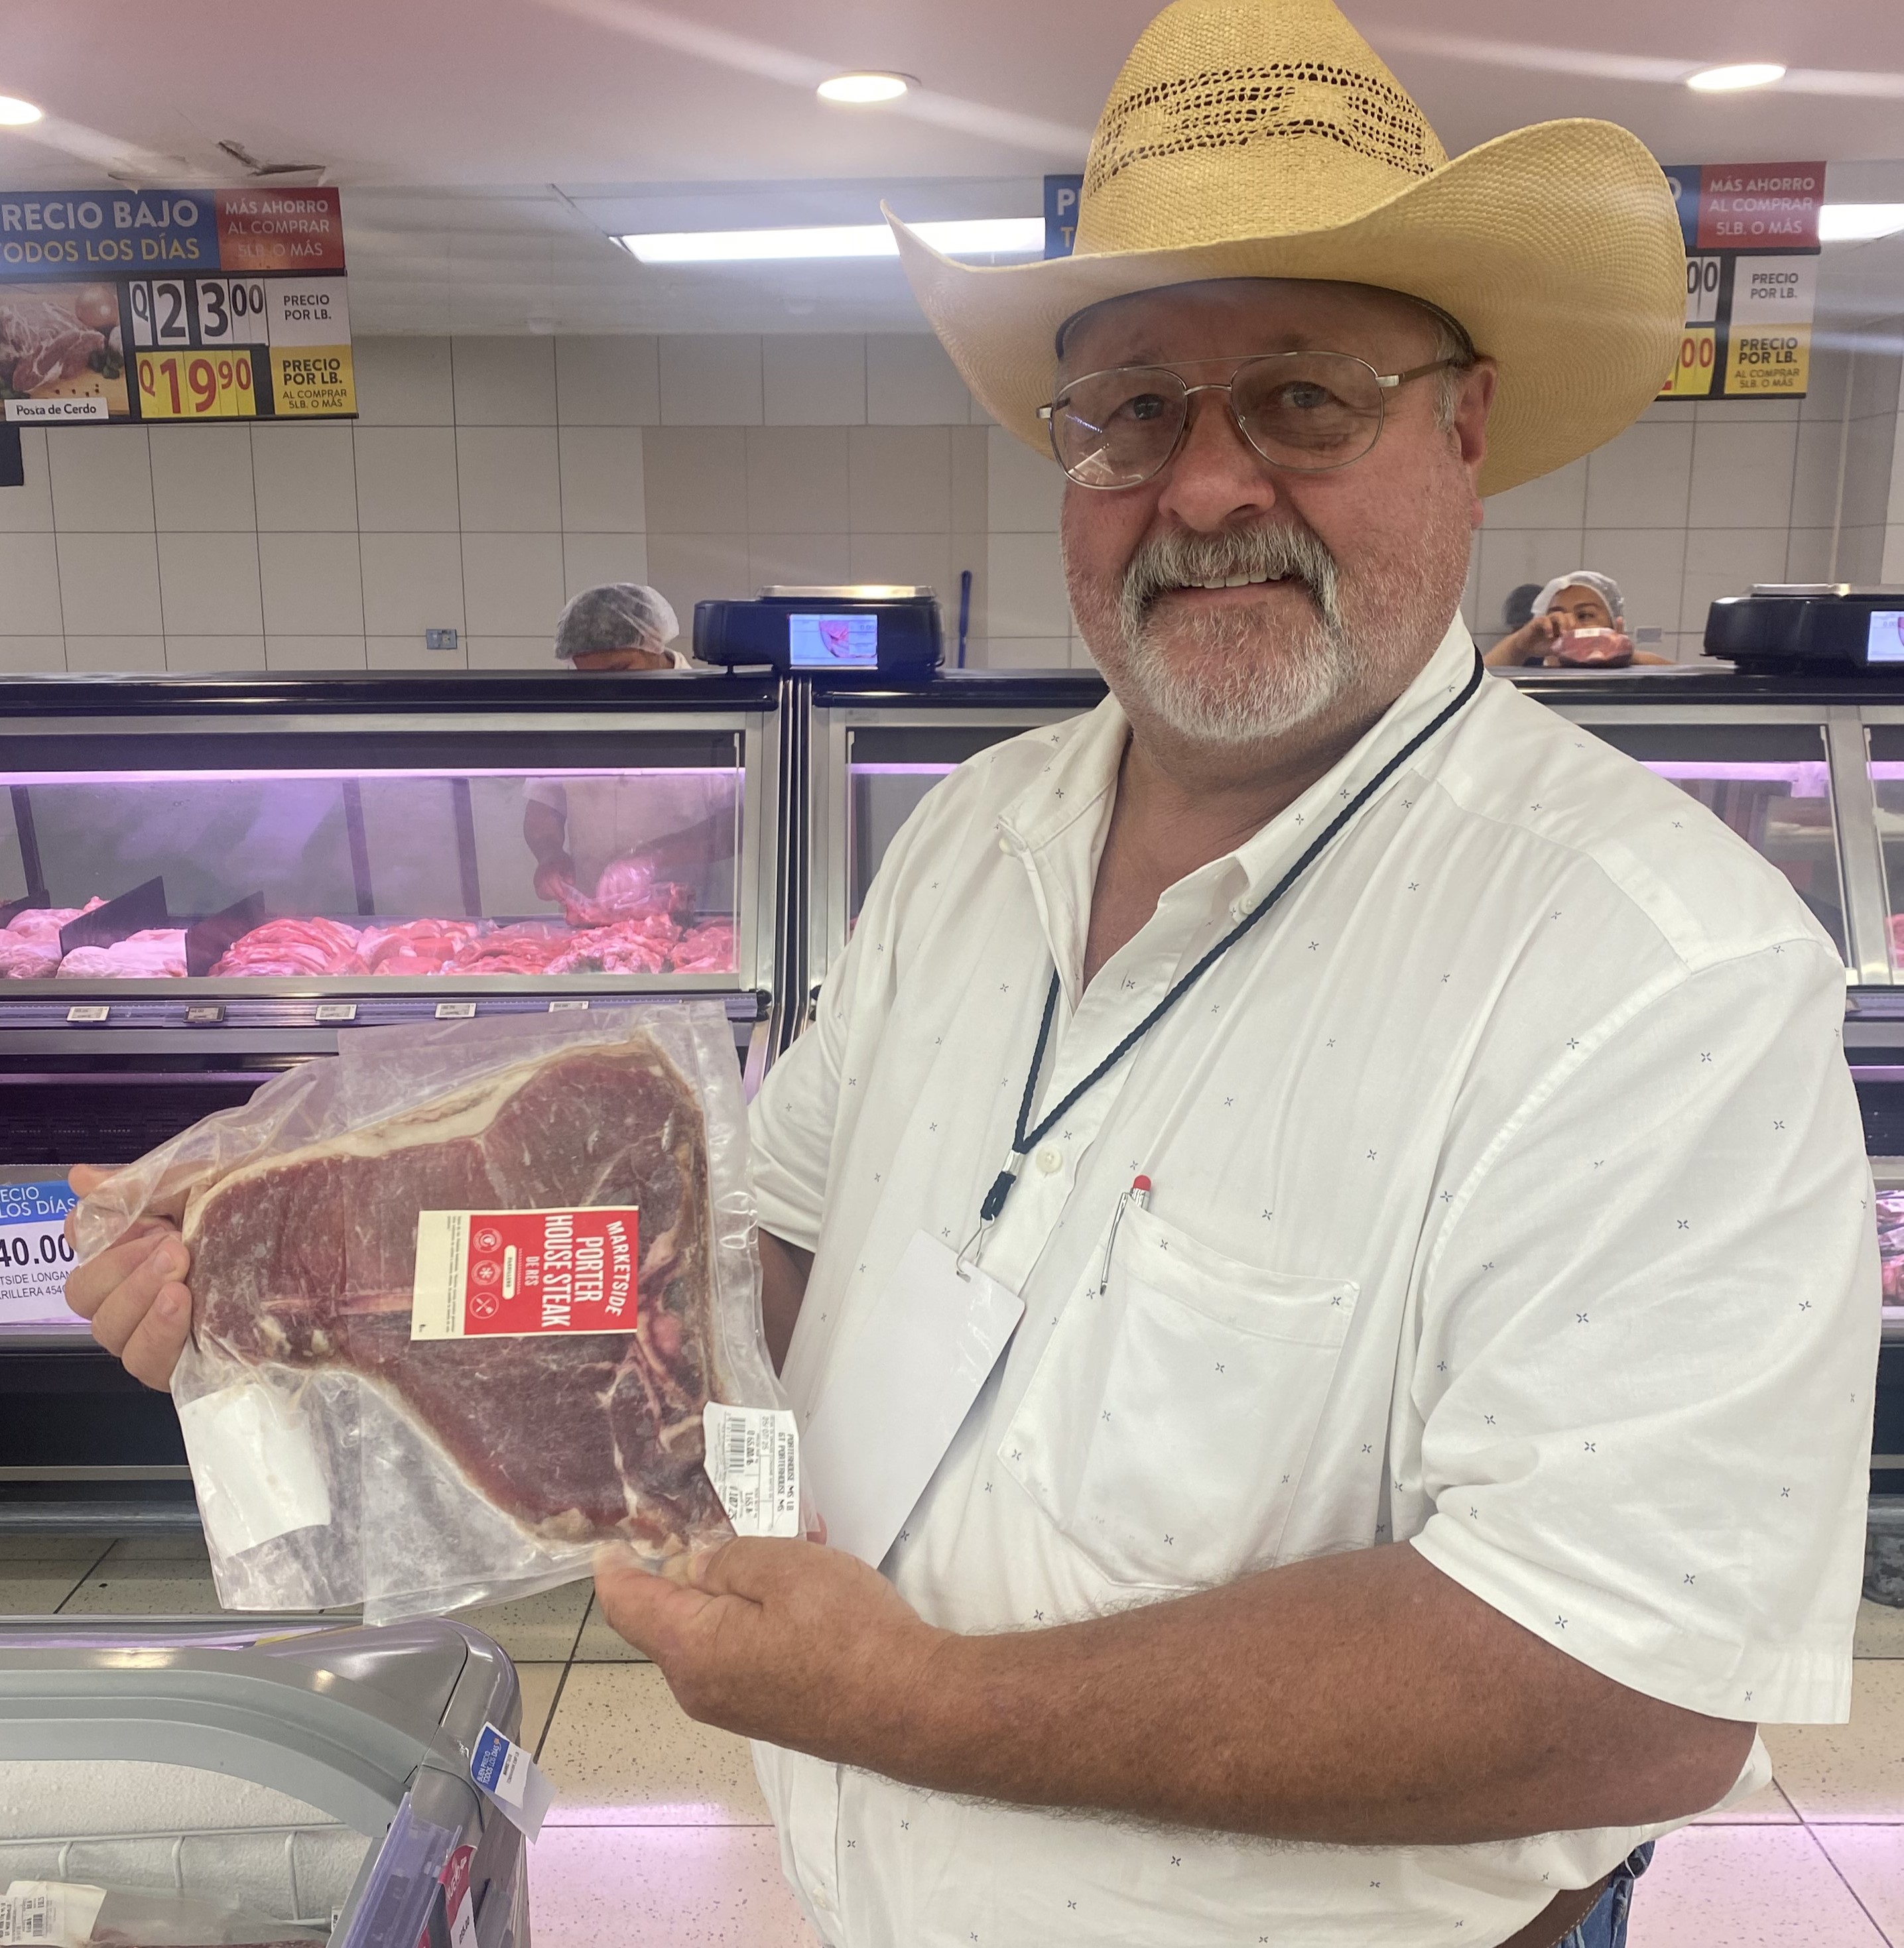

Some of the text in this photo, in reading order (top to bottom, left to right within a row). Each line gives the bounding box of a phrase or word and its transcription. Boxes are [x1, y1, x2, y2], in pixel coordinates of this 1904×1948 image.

[1710, 176, 1815, 192] MÁS AHORRO
[225, 198, 328, 215] MÁS AHORRO
[1709, 198, 1812, 212] AL COMPRAR
[113, 200, 198, 229] BAJO
[228, 219, 330, 235] AL COMPRAR
[1751, 221, 1765, 235] O
[1768, 217, 1803, 233] MÁS
[0, 233, 200, 263] ODOS LOS DÍAS
[290, 239, 323, 256] MÁS
[1751, 273, 1799, 284] PRECIO
[283, 294, 330, 306] PRECIO
[1751, 288, 1797, 299] POR LB.
[285, 309, 332, 320] POR LB.
[1740, 337, 1798, 351] PRECIO
[283, 358, 341, 372] PRECIO
[1739, 351, 1798, 365] POR LB.
[283, 372, 342, 385] POR LB.
[1749, 368, 1800, 378] COMPRAR
[283, 389, 347, 399] AL COMPRAR
[17, 403, 97, 416] Posta de Cerdo
[322, 398, 343, 408] MÁS
[0, 1186, 39, 1203] ECIO
[524, 1256, 540, 1286] DE RES
[541, 1215, 574, 1327] HOUSE STEAK
[575, 1236, 604, 1302] PORTER
[605, 1220, 630, 1317] MARKETSIDE
[0, 1287, 44, 1300] RILLERA
[482, 1765, 493, 1784] TODOS
